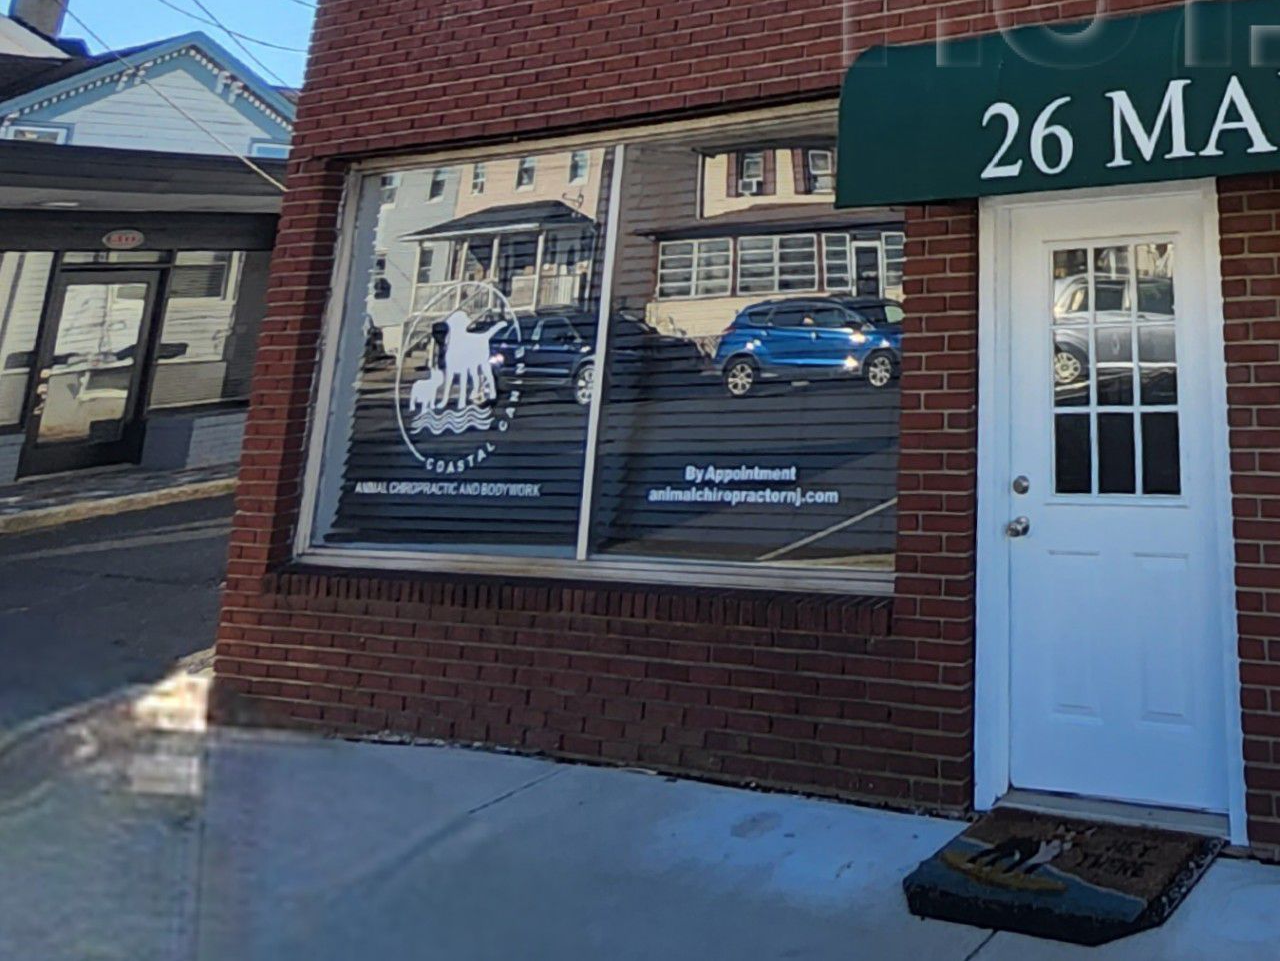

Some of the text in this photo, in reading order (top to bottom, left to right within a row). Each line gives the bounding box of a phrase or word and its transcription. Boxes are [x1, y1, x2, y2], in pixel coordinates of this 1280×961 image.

[980, 95, 1075, 180] 26
[425, 441, 496, 474] COASTAL
[685, 465, 797, 483] By Appointment
[354, 481, 388, 495] ANIMAL
[389, 482, 457, 495] CHIROPRACTIC
[459, 483, 480, 495] AND
[648, 486, 839, 507] animalchiropractornj.com
